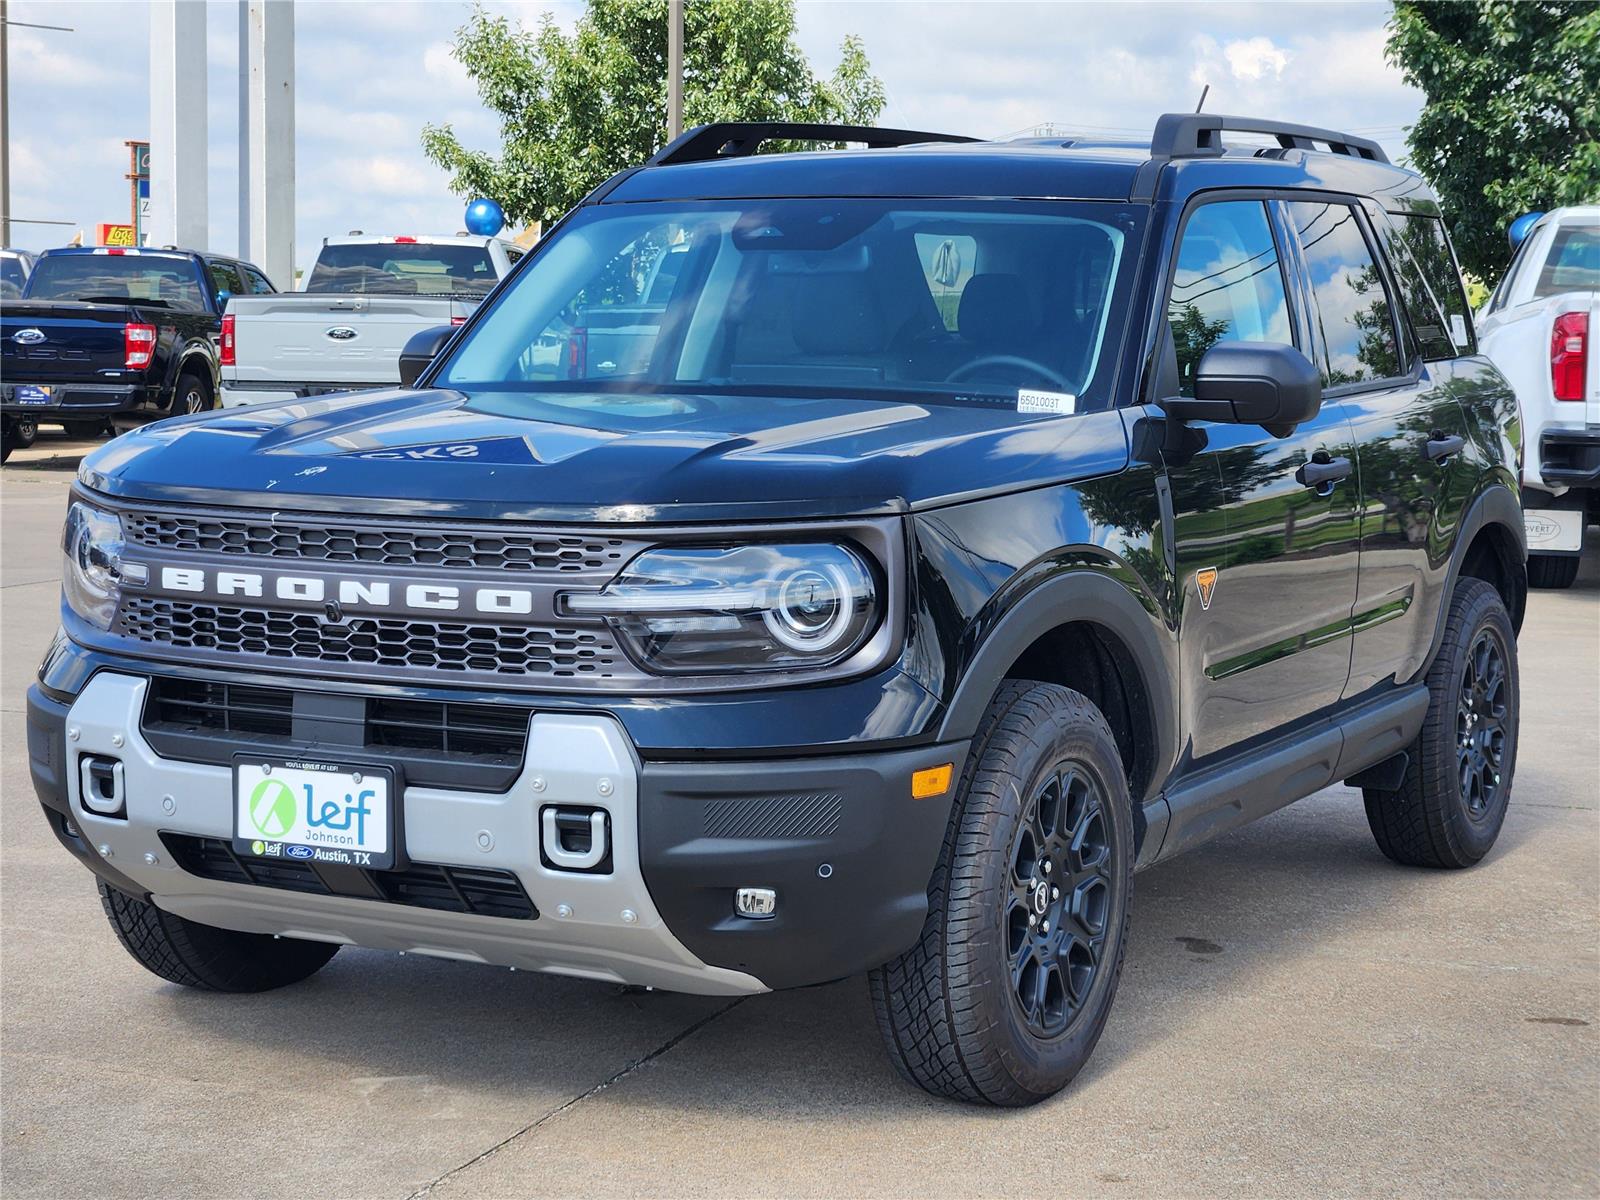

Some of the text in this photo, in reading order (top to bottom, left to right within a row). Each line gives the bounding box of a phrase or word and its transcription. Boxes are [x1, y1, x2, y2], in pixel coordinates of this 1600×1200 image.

[1020, 395, 1060, 408] 6501003T
[161, 566, 532, 614] BRONCO
[305, 829, 353, 846] Johnson
[314, 848, 351, 865] Austin,
[353, 852, 371, 865] TX
